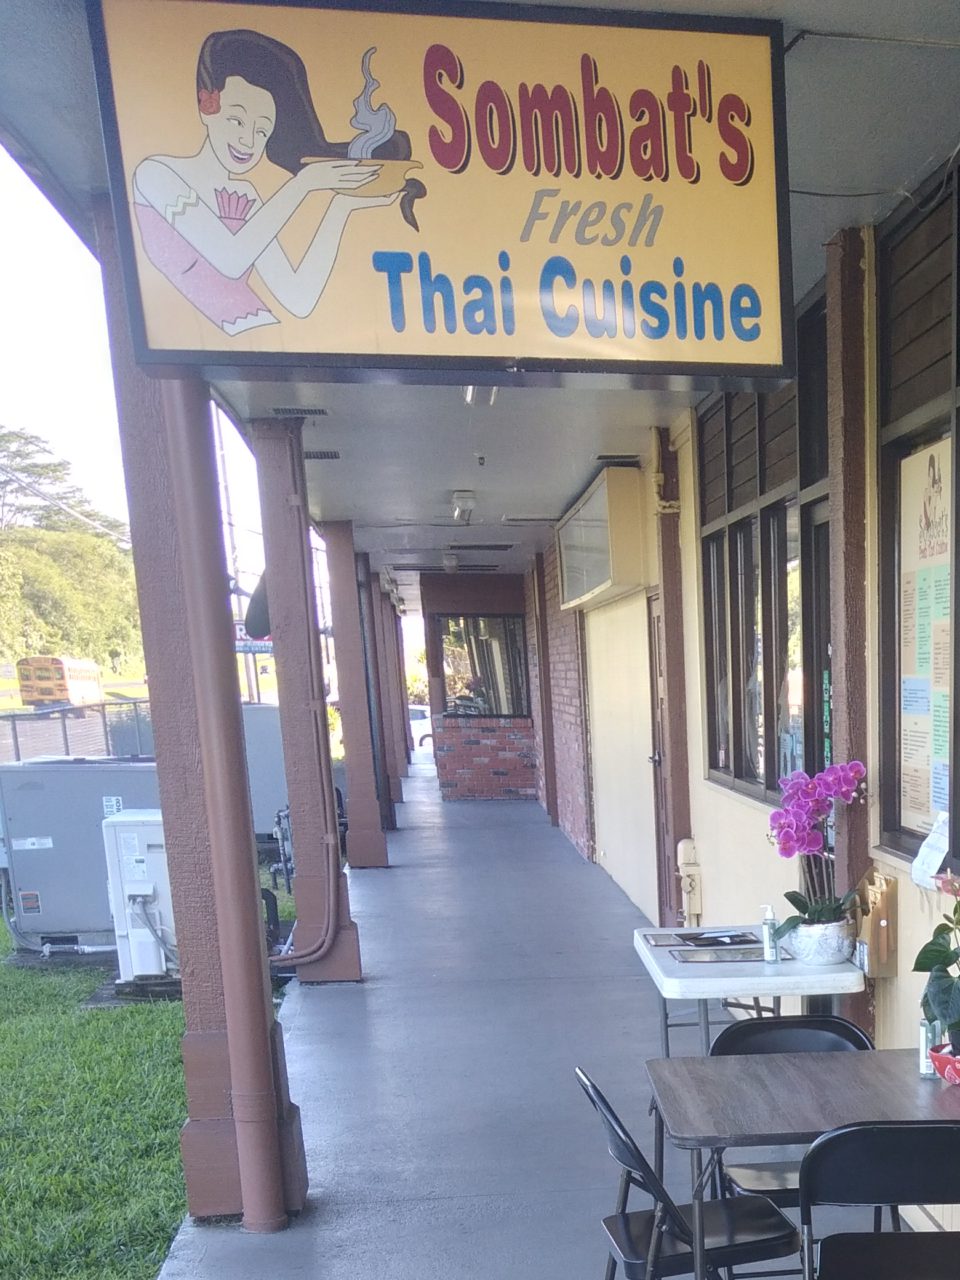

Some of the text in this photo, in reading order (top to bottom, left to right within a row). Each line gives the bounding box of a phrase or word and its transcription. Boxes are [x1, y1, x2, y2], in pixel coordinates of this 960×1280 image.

[422, 43, 754, 187] Sombat's
[519, 188, 664, 248] Fresh
[372, 250, 763, 342] Thai Cuisine
